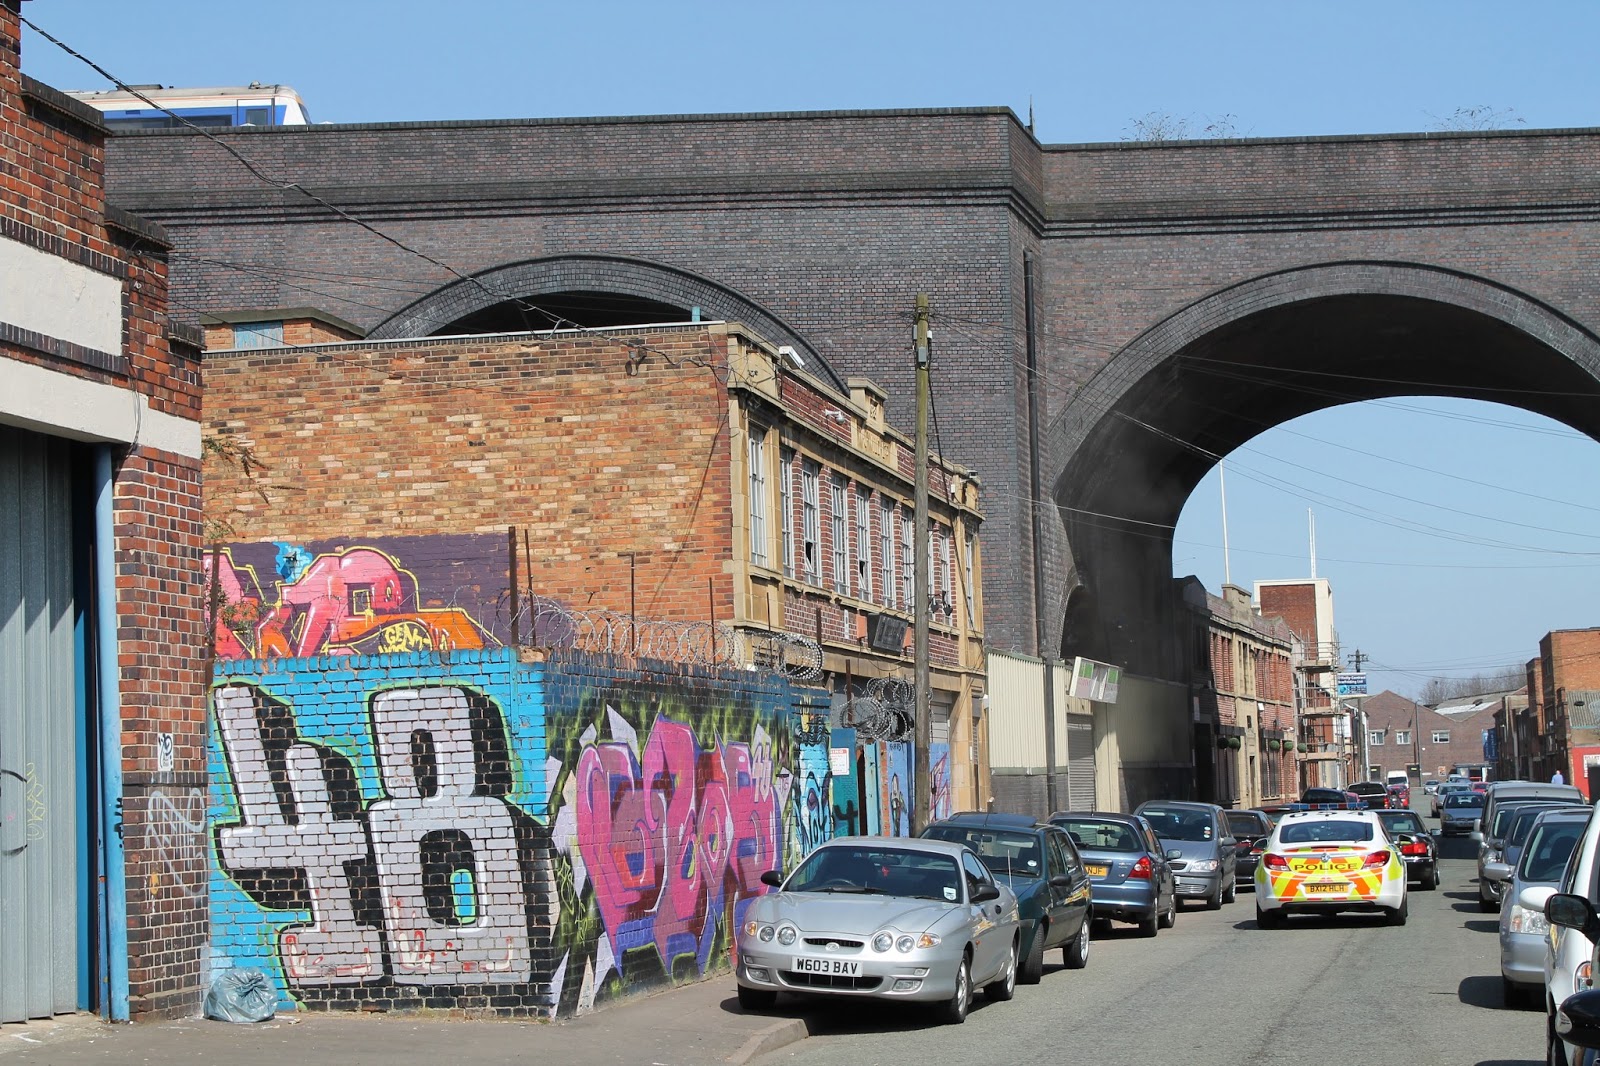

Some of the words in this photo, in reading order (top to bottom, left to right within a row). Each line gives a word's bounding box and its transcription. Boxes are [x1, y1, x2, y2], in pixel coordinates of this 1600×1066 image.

[210, 682, 540, 988] 48
[1294, 863, 1358, 871] POLICE
[797, 958, 830, 972] W603
[832, 961, 858, 975] BAV
